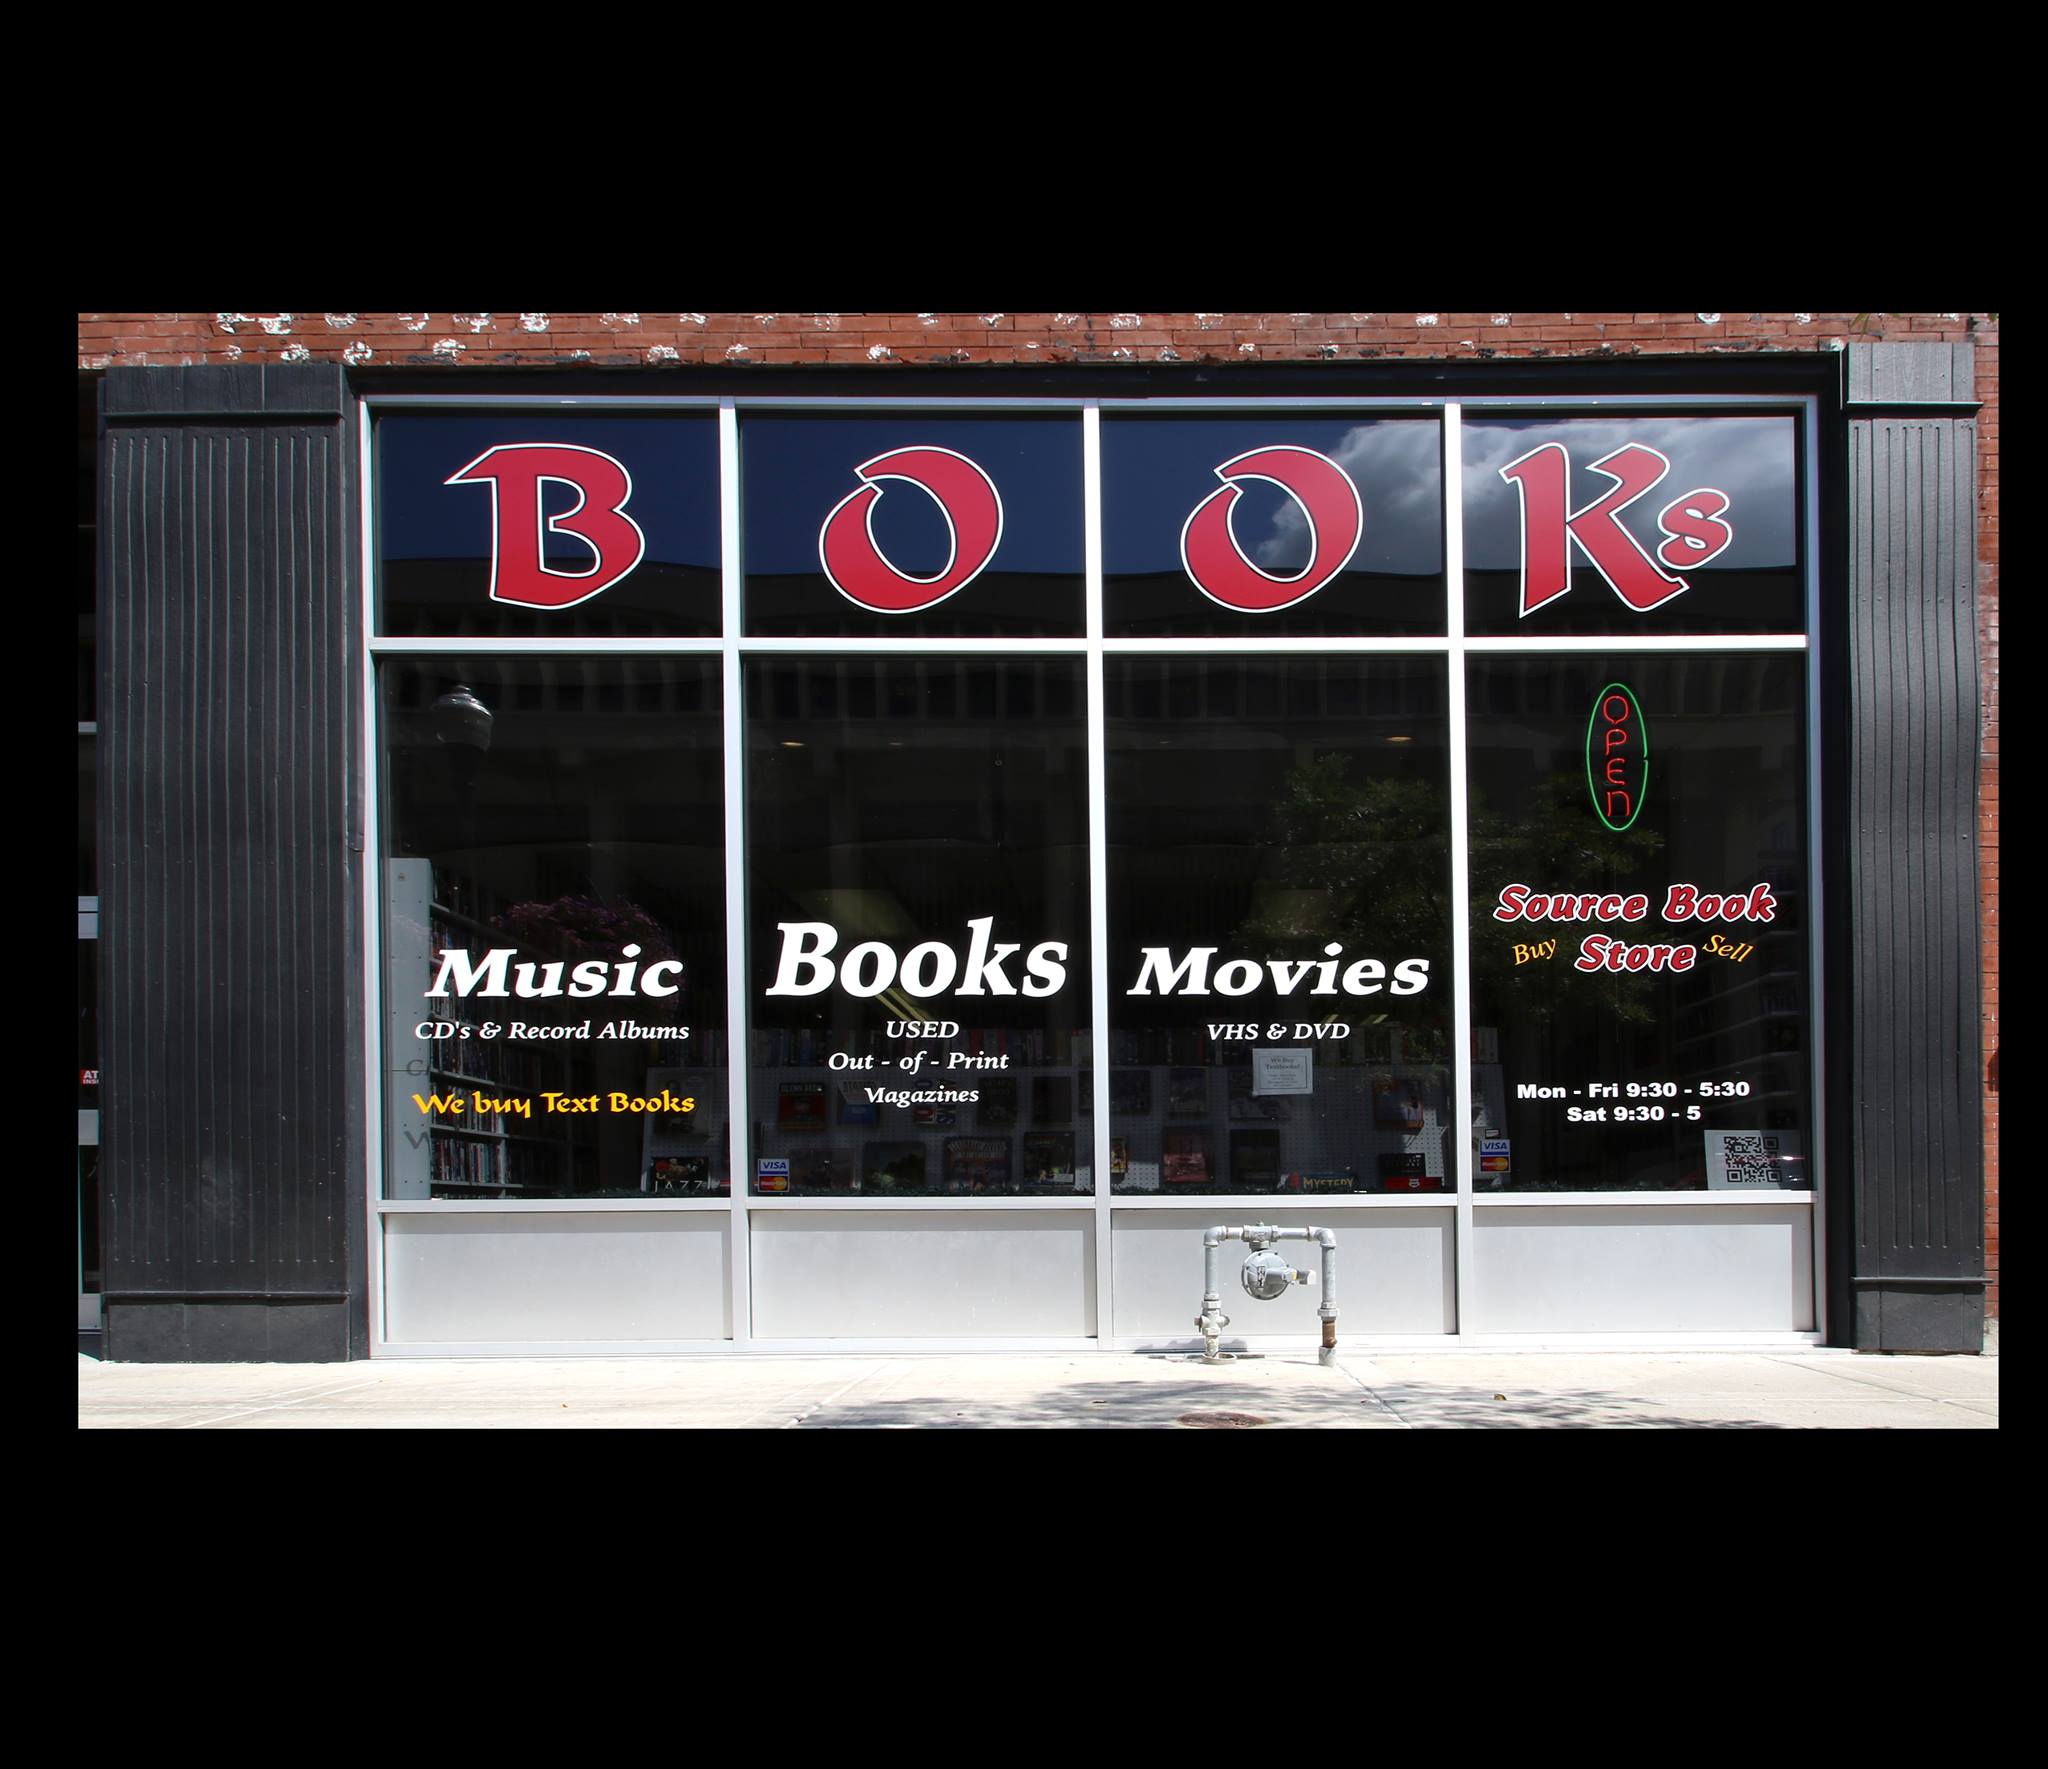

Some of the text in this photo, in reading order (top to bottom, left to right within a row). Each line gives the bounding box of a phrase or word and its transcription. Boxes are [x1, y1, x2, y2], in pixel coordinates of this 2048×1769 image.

[1493, 882, 1777, 922] Source Book
[765, 916, 1069, 998] Books
[1511, 937, 1557, 967] Buy
[1573, 933, 1697, 973] Store
[1703, 933, 1754, 964] Sell
[423, 943, 684, 998] Music
[1126, 942, 1430, 996] Movies
[414, 1020, 690, 1040] CD's & Record Albums
[886, 1020, 960, 1039] USED
[1207, 1023, 1351, 1041] VHS & DVD
[828, 1052, 875, 1071] Out
[899, 1050, 928, 1075] of
[946, 1050, 1010, 1070] Print
[1517, 1083, 1566, 1098] Mon
[1588, 1083, 1619, 1098] Fri
[1626, 1082, 1677, 1098] 9:30
[1699, 1081, 1750, 1097] 5:30
[411, 1089, 695, 1119] We buy Text Books
[1567, 1106, 1607, 1122] Sat
[1613, 1105, 1665, 1122] 9:30
[1686, 1105, 1701, 1121] 5
[1484, 1142, 1508, 1150] VISA
[762, 1161, 787, 1169] VISA
